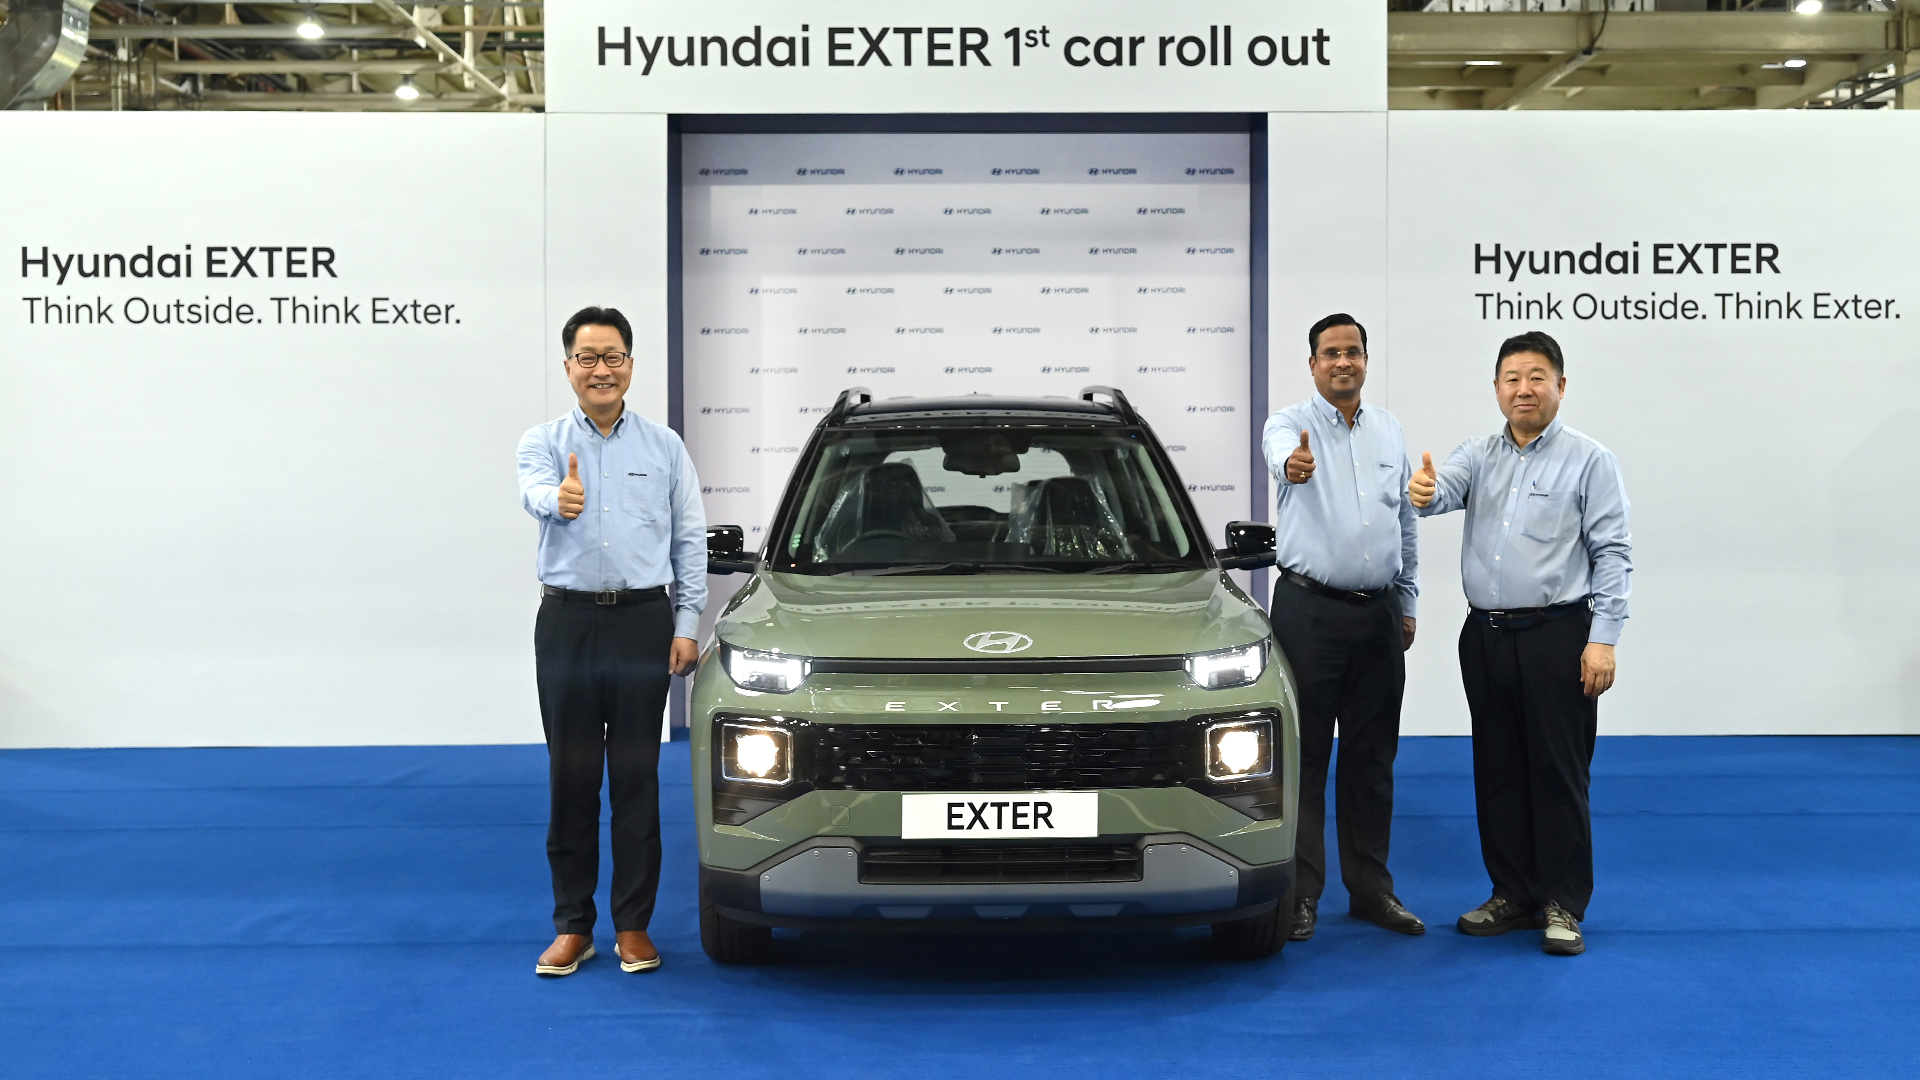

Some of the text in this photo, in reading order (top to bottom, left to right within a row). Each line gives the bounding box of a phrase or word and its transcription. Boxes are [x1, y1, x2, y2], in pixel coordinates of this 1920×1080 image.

[597, 23, 1331, 76] Hyundai EXTER 1st car roll out
[761, 207, 798, 215] HYUNDAI
[858, 207, 895, 215] HYUNDAI
[712, 247, 749, 255] HYUNDAI
[810, 247, 847, 255] HYUNDAI
[21, 244, 339, 286] Hyundai EXTER
[1474, 240, 1782, 282] Hyundai EXTER
[762, 287, 799, 295] HYUNDAI
[858, 287, 895, 295] HYUNDAI
[956, 286, 993, 294] HYUNDAI
[1053, 286, 1090, 294] HYUNDAI
[1150, 286, 1187, 294] HYUNDAI
[22, 295, 461, 325] Think Outside. Think Exter.
[1474, 291, 1901, 321] Think Outside. Think Exter.
[713, 326, 750, 334] HYUNDAI
[811, 326, 848, 334] HYUNDAI
[908, 326, 945, 334] HYUNDAI
[1004, 326, 1041, 334] HYUNDAI
[1101, 325, 1138, 333] HYUNDAI
[1199, 325, 1236, 333] HYUNDAI
[763, 366, 800, 374] HYUNDAI
[859, 366, 896, 374] HYUNDAI
[956, 365, 993, 373] HYUNDAI
[1053, 365, 1090, 373] HYUNDAI
[1150, 365, 1187, 373] HYUNDAI
[713, 406, 750, 414] HYUNDAI
[1199, 405, 1236, 413] HYUNDAI
[762, 445, 799, 453] HYUNDAI
[715, 485, 752, 493] HYUNDAI
[1199, 484, 1236, 492] HYUNDAI
[884, 699, 1114, 713] EXTER
[946, 801, 1055, 831] EXTER
